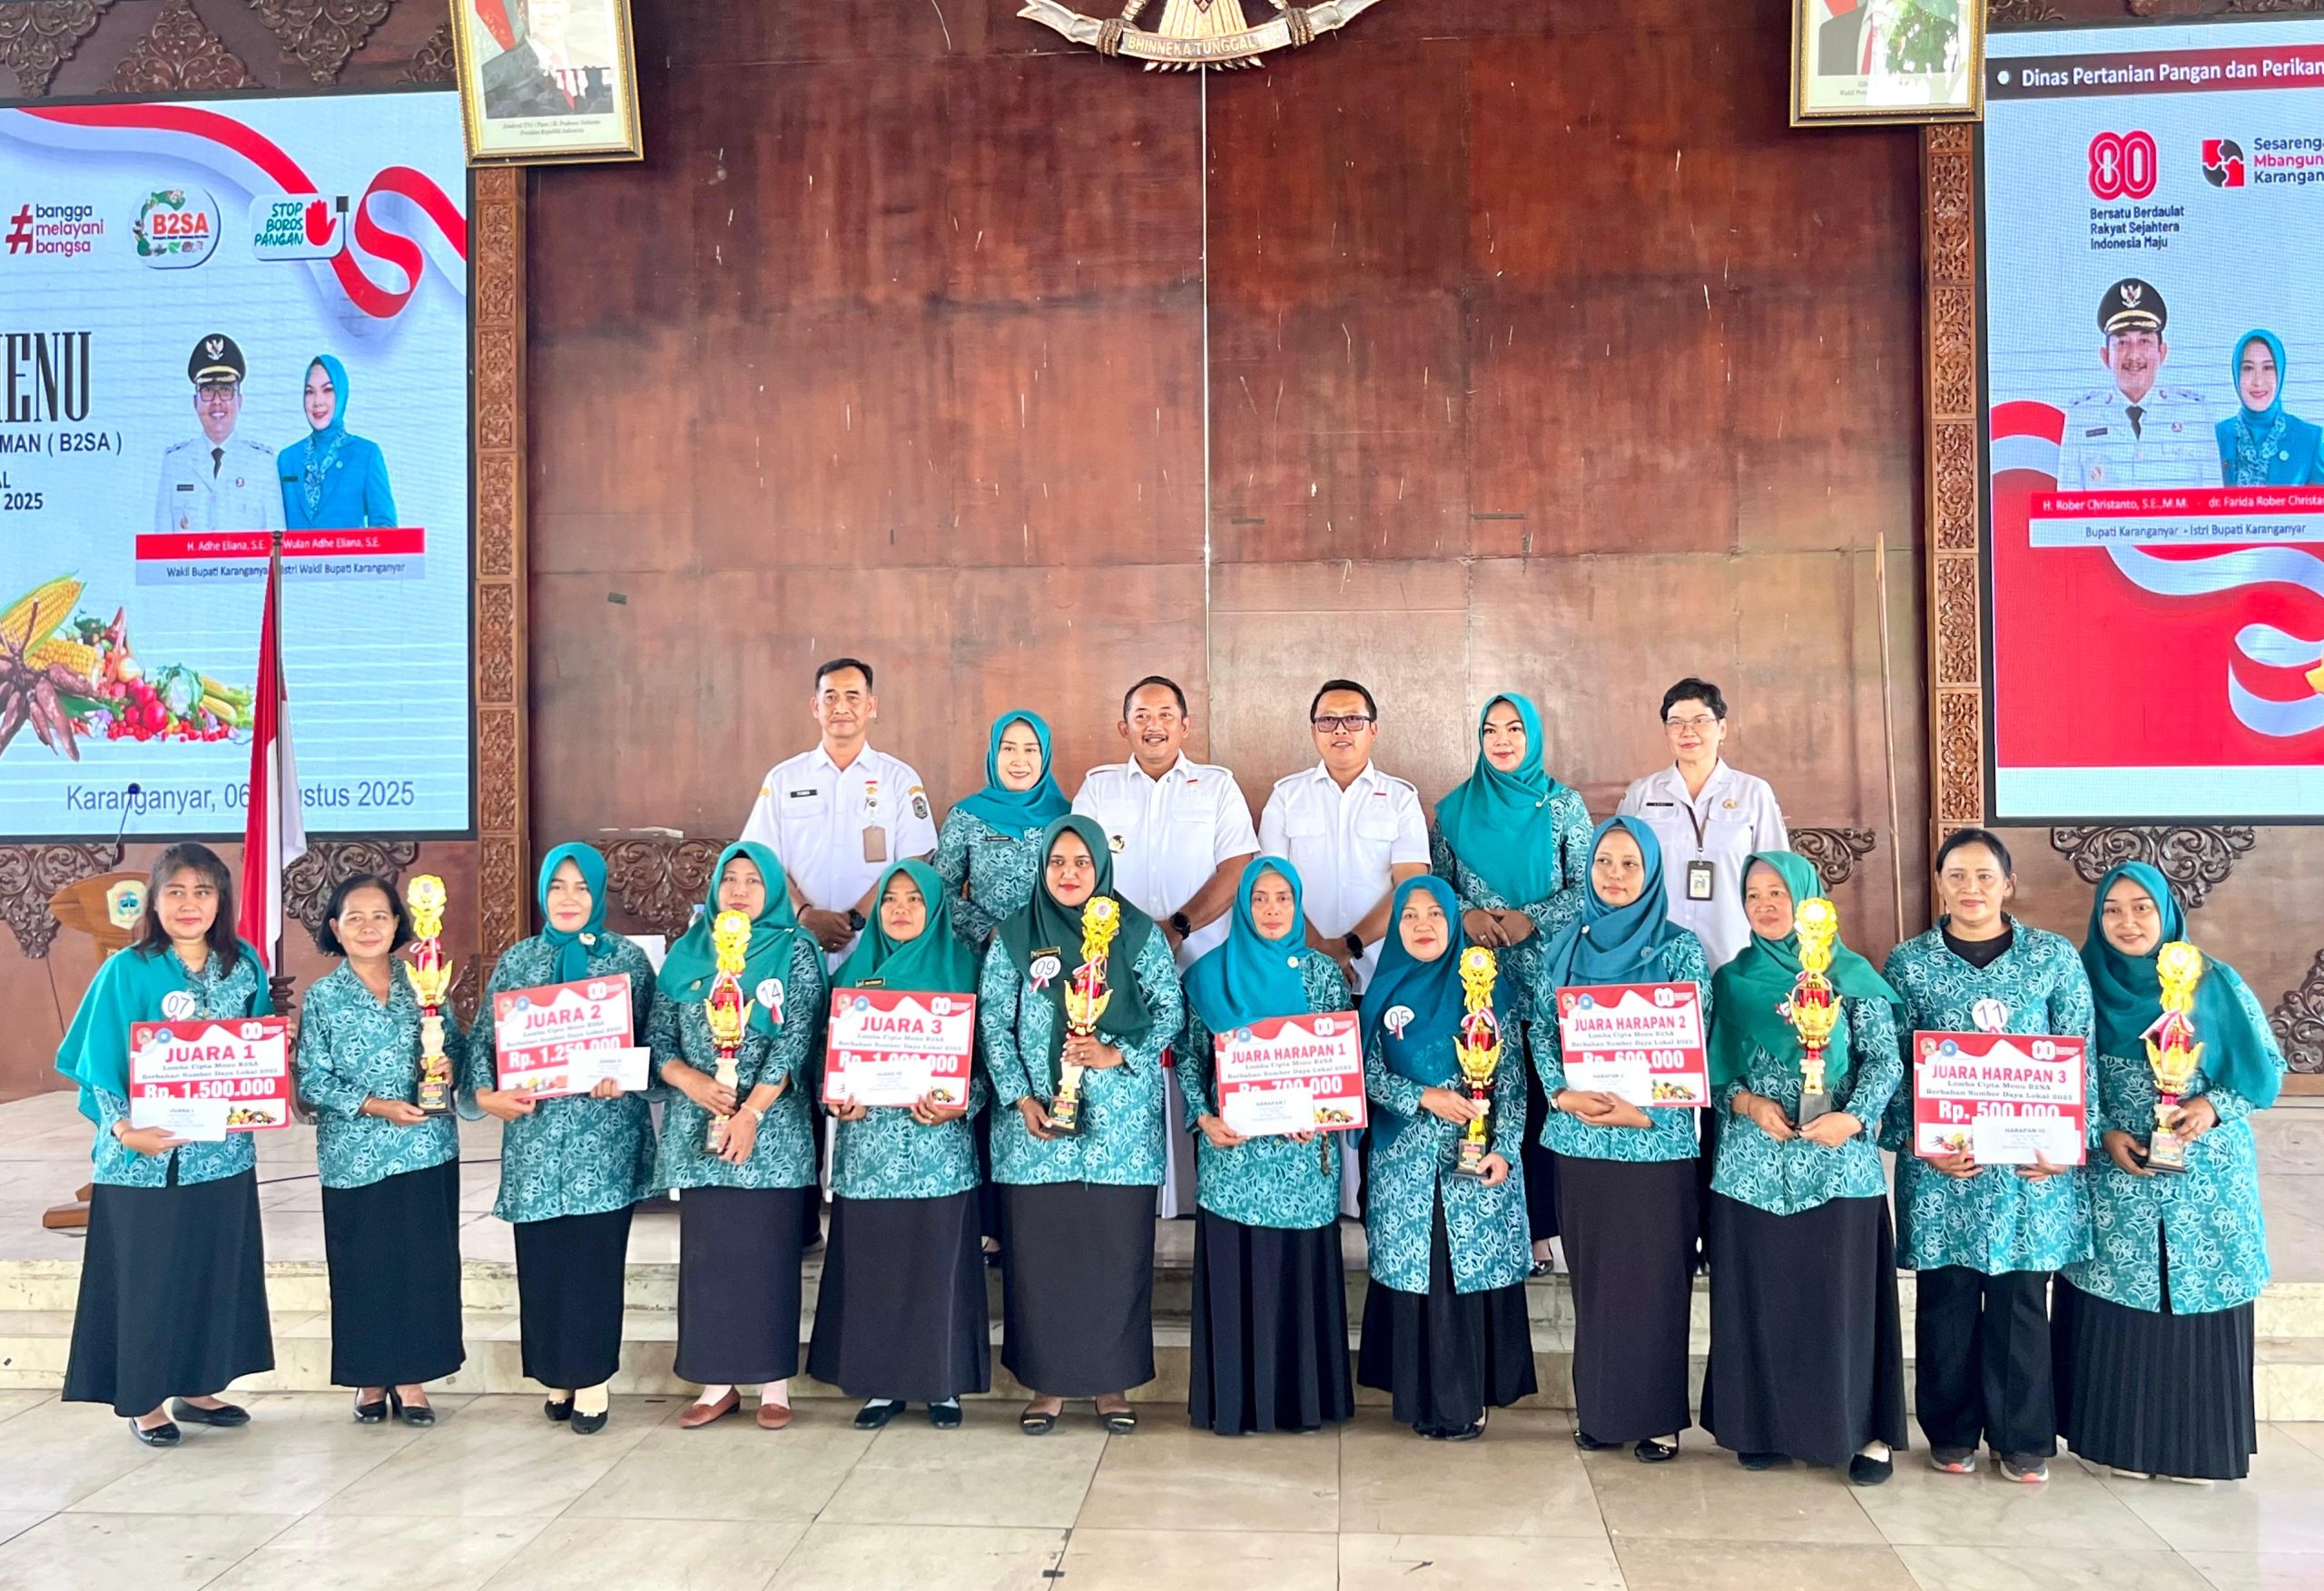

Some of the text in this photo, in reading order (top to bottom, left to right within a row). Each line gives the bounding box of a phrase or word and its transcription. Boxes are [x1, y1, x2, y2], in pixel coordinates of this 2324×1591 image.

[1128, 35, 1192, 55] BHINNEKA
[1193, 35, 1257, 54] TUNGGAL
[2022, 68, 2069, 87] Dinas
[2073, 64, 2155, 85] Pertanian
[2159, 64, 2221, 84] Pangan
[2225, 60, 2257, 78] dan
[2254, 137, 2324, 152] Sesareng
[2088, 130, 2157, 201] 80
[2254, 153, 2324, 169] Mbangun
[36, 203, 93, 221] bangga
[272, 202, 303, 218] STOP
[2090, 205, 2185, 220] Bersatu Berdaulat
[36, 219, 103, 240] melayani
[153, 212, 210, 235] B2SA
[266, 218, 303, 233] BOROS
[2091, 221, 2180, 236] Rakyat Sejahtera
[36, 239, 91, 257] bangsa
[254, 232, 303, 248] PANGAN
[2091, 236, 2168, 250] Indonesia Maju
[0, 331, 92, 423] ENU
[5, 492, 44, 510] 2025
[2043, 501, 2053, 511] H.
[2056, 499, 2084, 510] Rober
[2088, 498, 2140, 510] Christanto,
[2209, 496, 2221, 508] dr.
[2224, 496, 2254, 507] Farida
[2256, 495, 2286, 506] Rober
[2289, 494, 2324, 506] Christa
[2085, 526, 2116, 539] Bupati
[2119, 525, 2179, 538] Karanganyar
[2191, 525, 2209, 535] Istri
[2211, 524, 2243, 536] Bupati
[2246, 524, 2307, 535] Karanganyar
[187, 541, 196, 551] H.
[198, 540, 221, 551] Adhe
[222, 540, 250, 551] Eliana,
[283, 538, 310, 549] Wulan
[311, 537, 335, 548] Adhe
[166, 566, 190, 577] Wakil
[192, 566, 219, 578] Bupati
[221, 565, 268, 577] Karanganya
[300, 564, 322, 574] Wakil
[325, 564, 351, 575] Bupati
[354, 563, 406, 574] Karanganyar
[67, 784, 216, 815] Karanganyar,
[224, 783, 250, 808] 06
[358, 781, 415, 806] 2025
[1035, 960, 1056, 976] 09
[761, 983, 782, 1003] 14
[167, 995, 190, 1015] 07
[525, 1005, 601, 1029] JUARA 2
[1390, 1010, 1410, 1026] 05
[1977, 1003, 2004, 1026] 11
[861, 1016, 942, 1034] JUARA 3
[1574, 1016, 1686, 1032] JUARA HARAPAN 2
[165, 1045, 255, 1063] JUARA 1
[508, 1051, 535, 1069] Rp.
[1231, 1043, 1345, 1064] JUARA HARAPAN 1
[1932, 1066, 2066, 1084] JUARA HARAPAN 3
[181, 1078, 276, 1098] 1.500.000
[1938, 1100, 1970, 1123] Rp.
